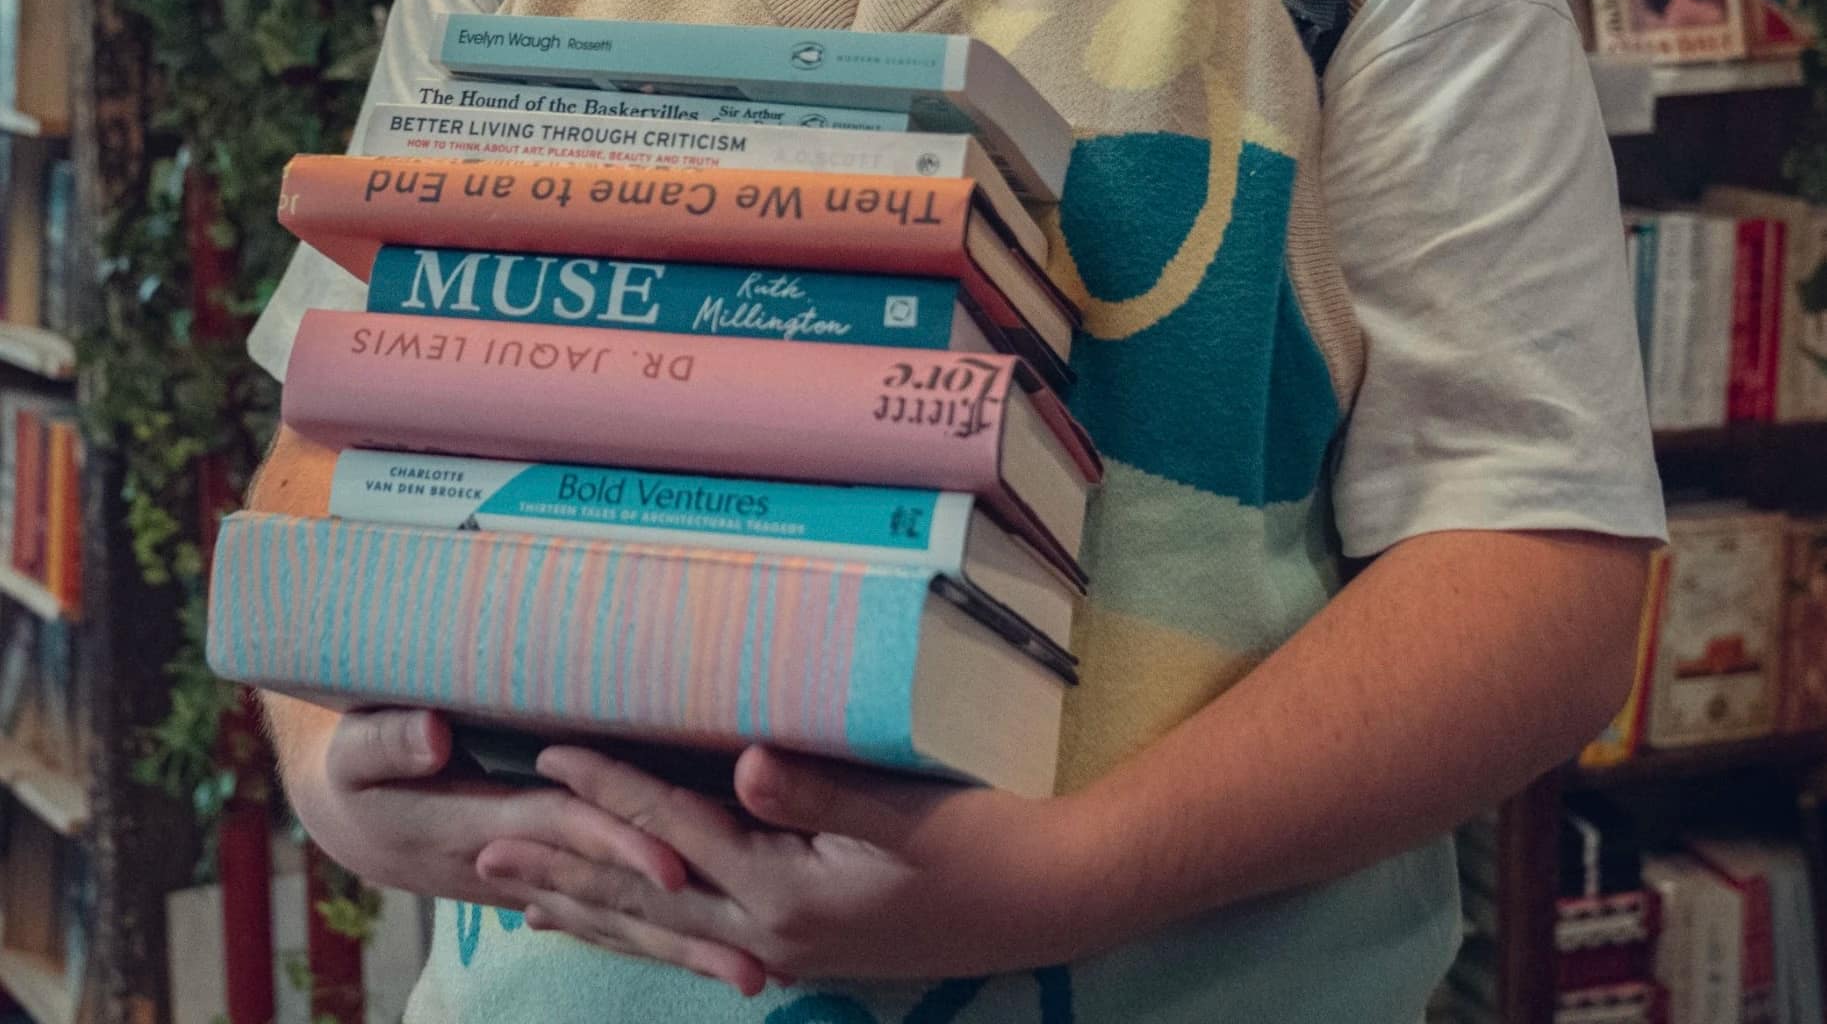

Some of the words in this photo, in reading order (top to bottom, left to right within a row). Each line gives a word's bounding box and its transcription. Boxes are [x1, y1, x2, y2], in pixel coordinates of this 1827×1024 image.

[458, 29, 504, 48] Evelyn
[508, 31, 560, 51] Waugh
[567, 37, 613, 52] Rossetti
[419, 87, 454, 106] The
[459, 90, 519, 110] Hound
[525, 94, 545, 112] of
[548, 96, 577, 114] the
[584, 99, 699, 121] Baskervilles
[719, 104, 740, 118] Sir
[742, 107, 784, 121] Arthur
[390, 115, 463, 136] BETTER
[469, 119, 535, 139] LIVING
[541, 124, 637, 146] THROUGH
[643, 131, 747, 152] CRITICISM
[407, 138, 429, 149] HOW
[433, 140, 446, 150] TO
[450, 141, 480, 152] THINK
[483, 143, 519, 155] ABOUT
[609, 151, 651, 163] BEAUTY
[655, 154, 678, 165] AND
[682, 156, 720, 166] TRUTH
[365, 169, 447, 203] End
[464, 173, 514, 199] an
[531, 177, 572, 208] to
[590, 174, 717, 216] Came
[736, 184, 803, 220] We
[825, 186, 941, 225] Then
[402, 249, 666, 324] MUSE
[737, 272, 806, 299] Ruth
[692, 295, 851, 342] Millington
[351, 327, 466, 364] LEWIS
[484, 339, 611, 374] JAQUI
[632, 350, 695, 382] DR.
[365, 479, 393, 493] VAN
[397, 482, 425, 496] DEN
[430, 485, 483, 500] BROECK
[389, 466, 465, 482] CHARLOTTE
[557, 473, 625, 506] Bold
[638, 479, 770, 517] Ventures
[519, 502, 578, 517] THIRTEEN
[581, 507, 617, 520] TALES
[620, 509, 637, 521] OF
[641, 511, 742, 528] ARCHITECTURAL
[746, 519, 806, 534] TRAGEDY
